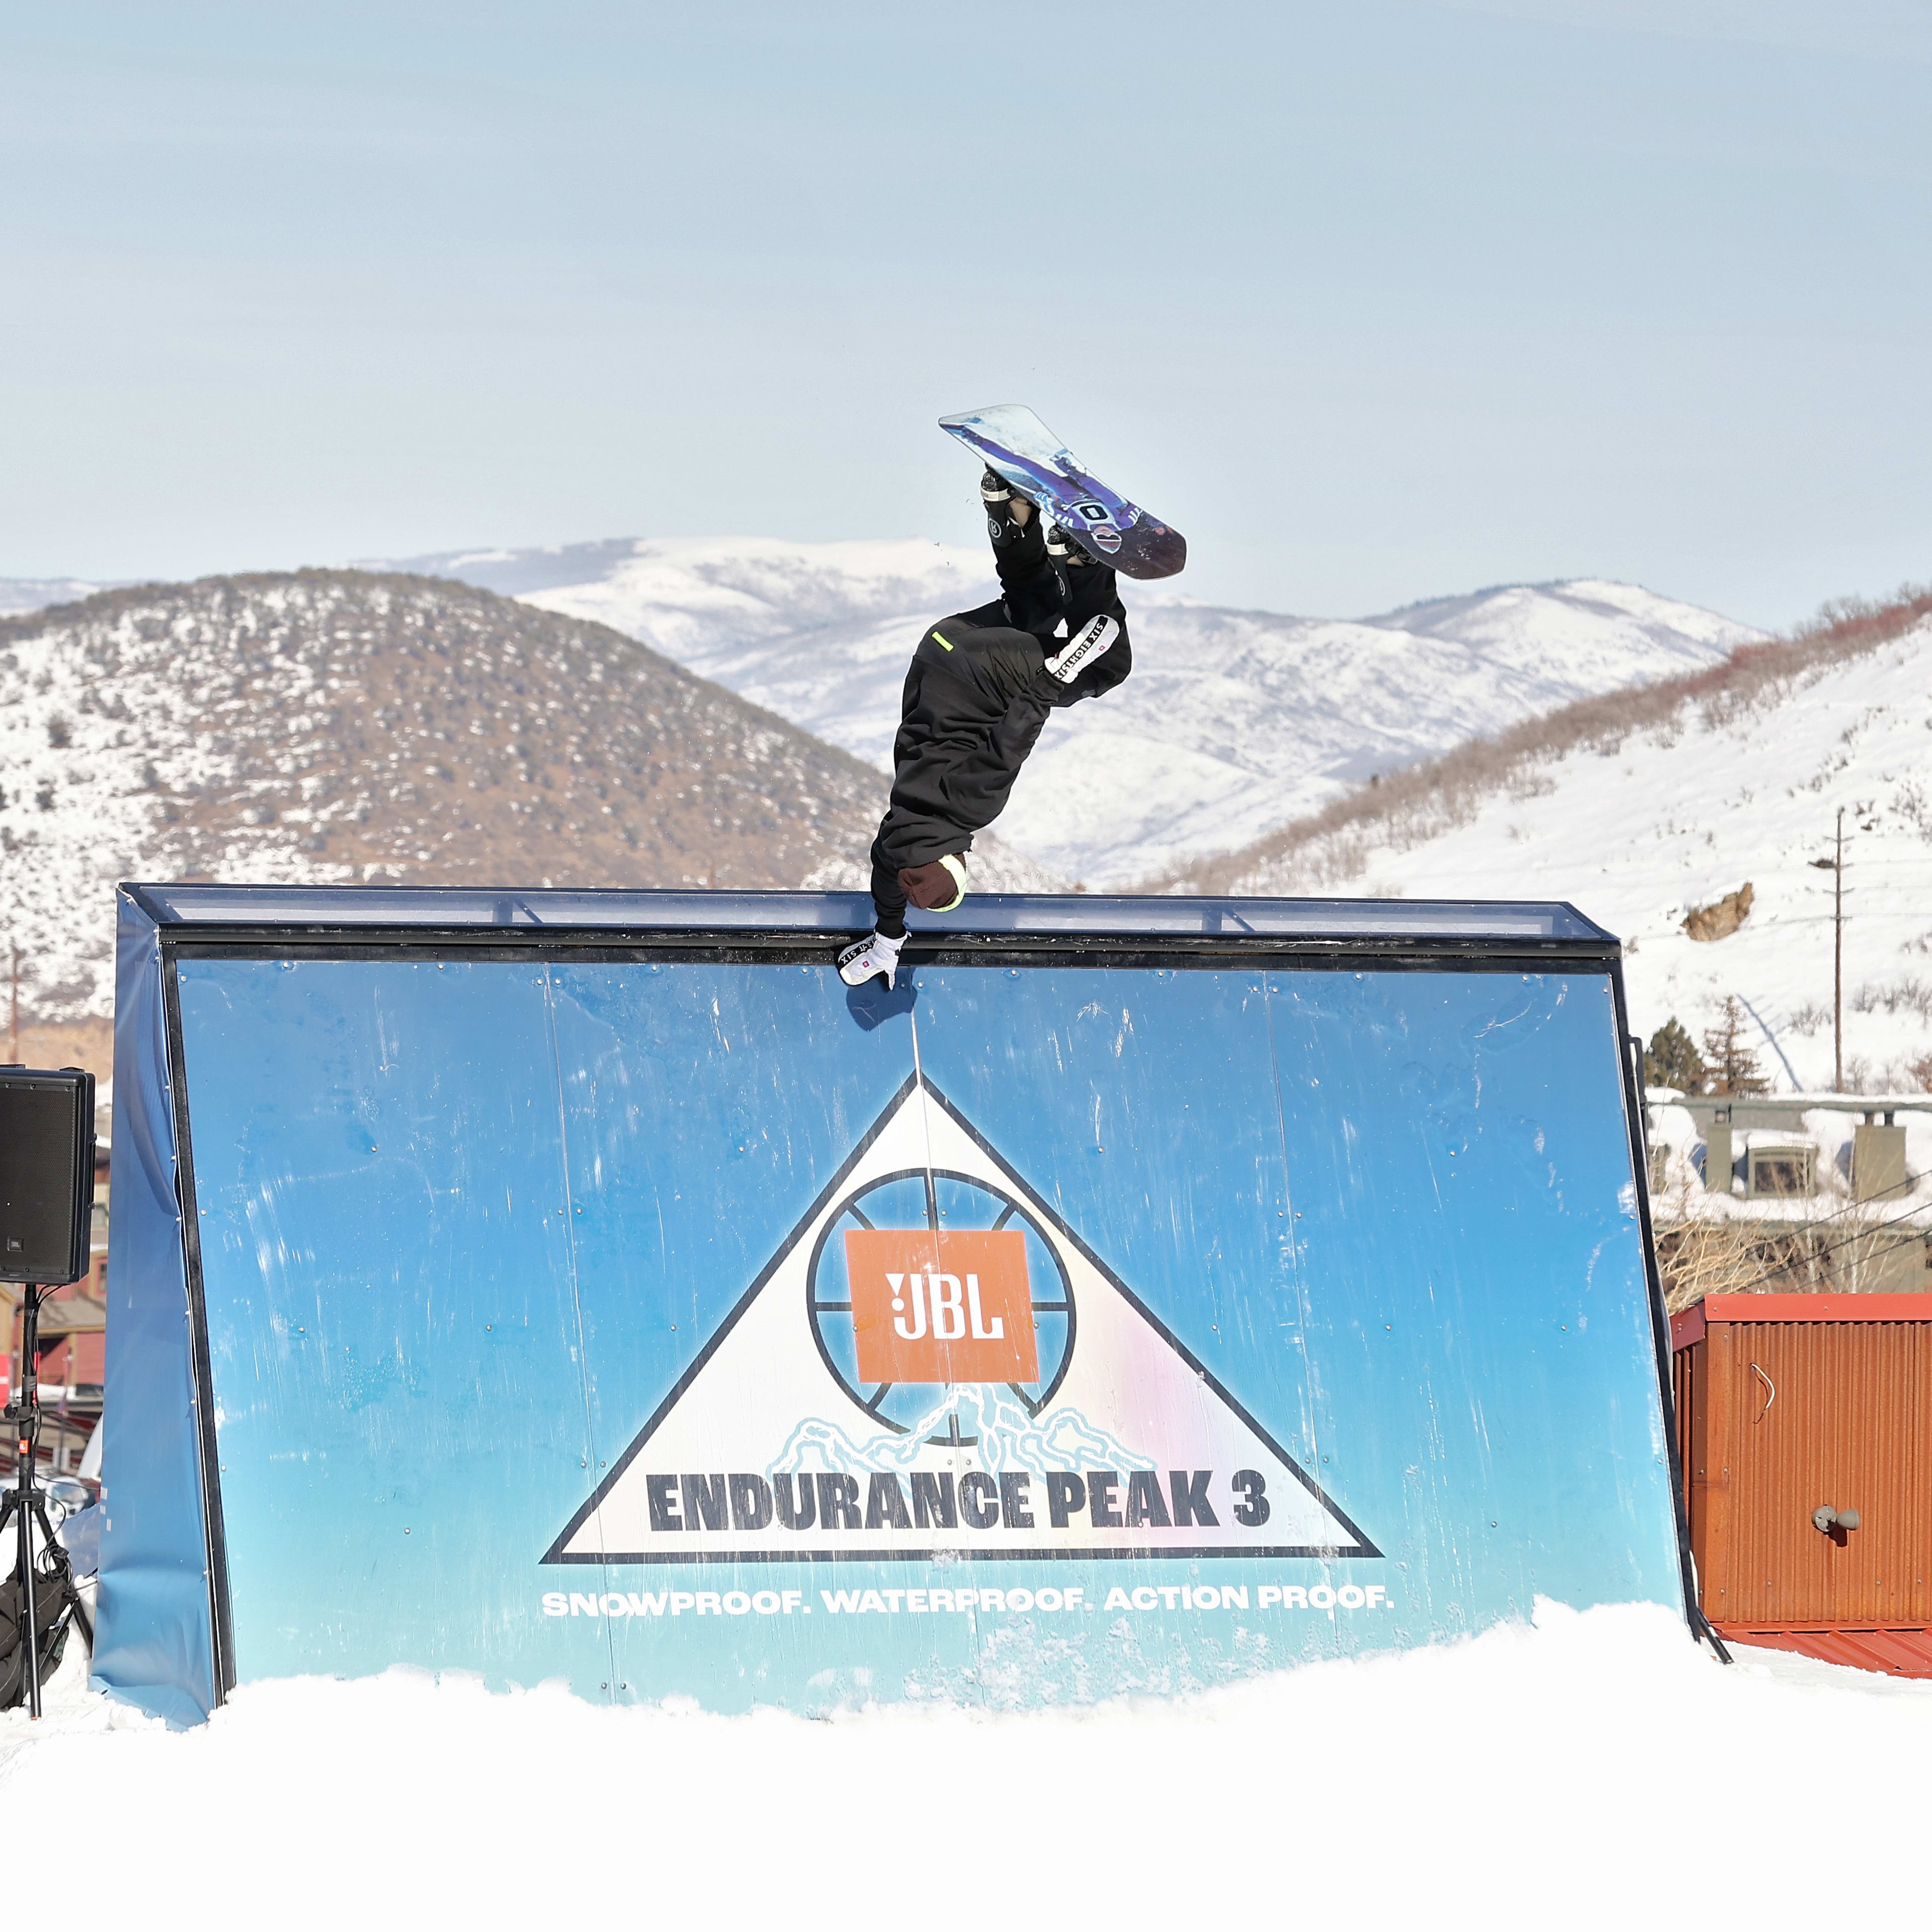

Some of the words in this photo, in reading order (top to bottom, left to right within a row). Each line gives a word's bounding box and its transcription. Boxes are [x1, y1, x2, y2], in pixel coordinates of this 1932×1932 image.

[1089, 623, 1103, 640] SIX
[841, 950, 857, 964] SIX
[890, 1273, 1004, 1339] JBL
[646, 1472, 1034, 1531] ENDURANCE
[1045, 1470, 1221, 1528] PEAK
[1232, 1469, 1270, 1527] 3
[541, 1590, 812, 1617] SNOWPROOF.
[1103, 1586, 1249, 1611] ACTION
[1258, 1585, 1395, 1609] PROOF.
